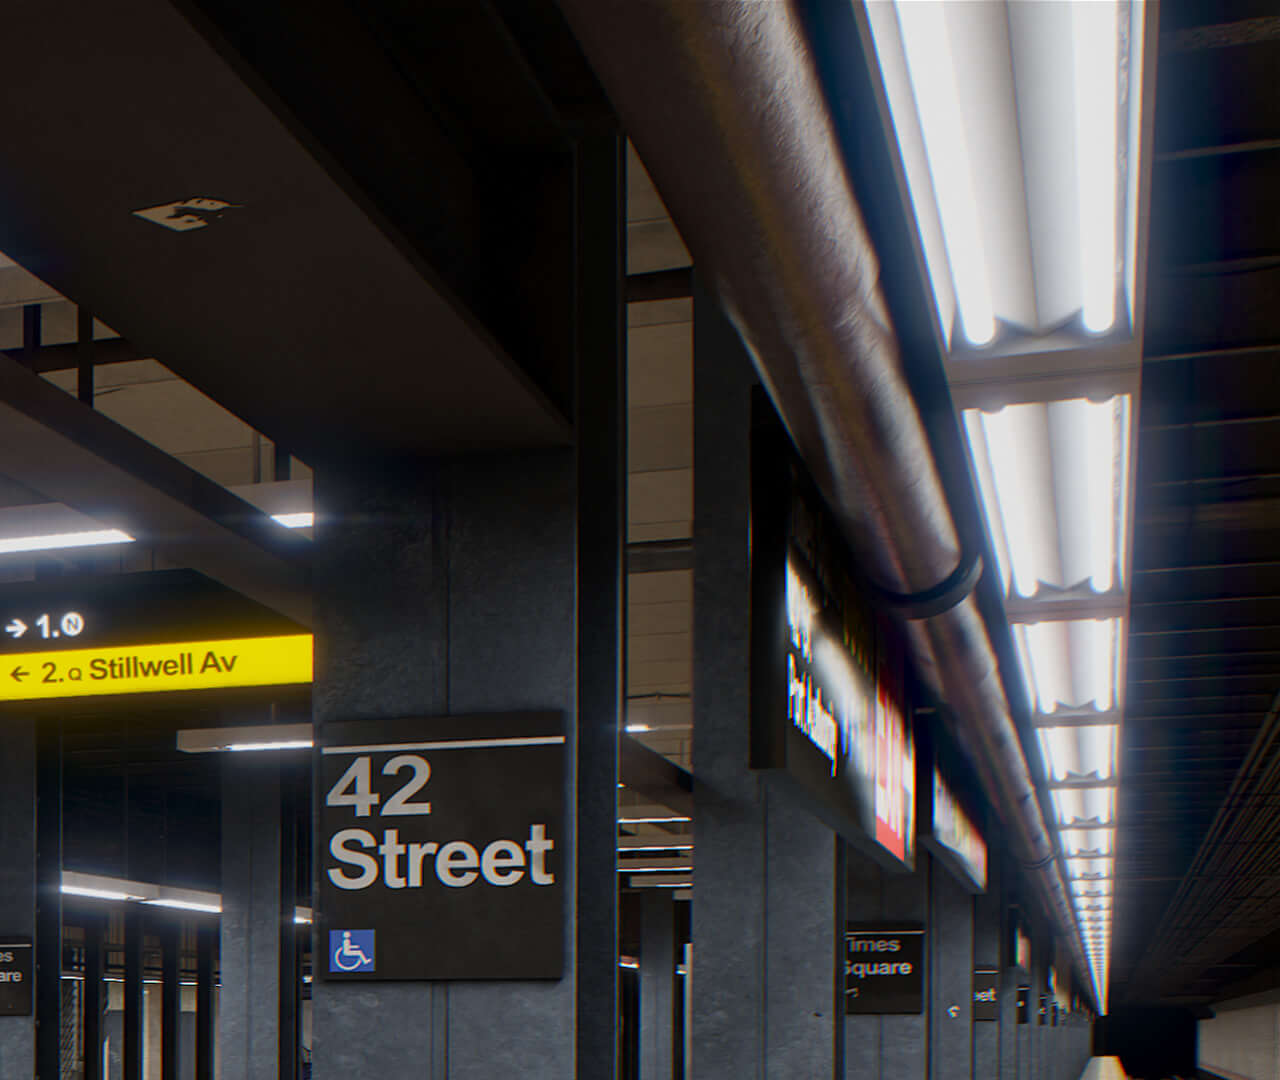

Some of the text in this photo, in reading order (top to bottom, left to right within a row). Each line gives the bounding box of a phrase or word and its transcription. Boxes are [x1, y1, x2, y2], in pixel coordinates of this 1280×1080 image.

[90, 652, 193, 680] Stillwell
[200, 651, 238, 674] Av
[326, 754, 432, 817] 42
[327, 823, 555, 890] Street
